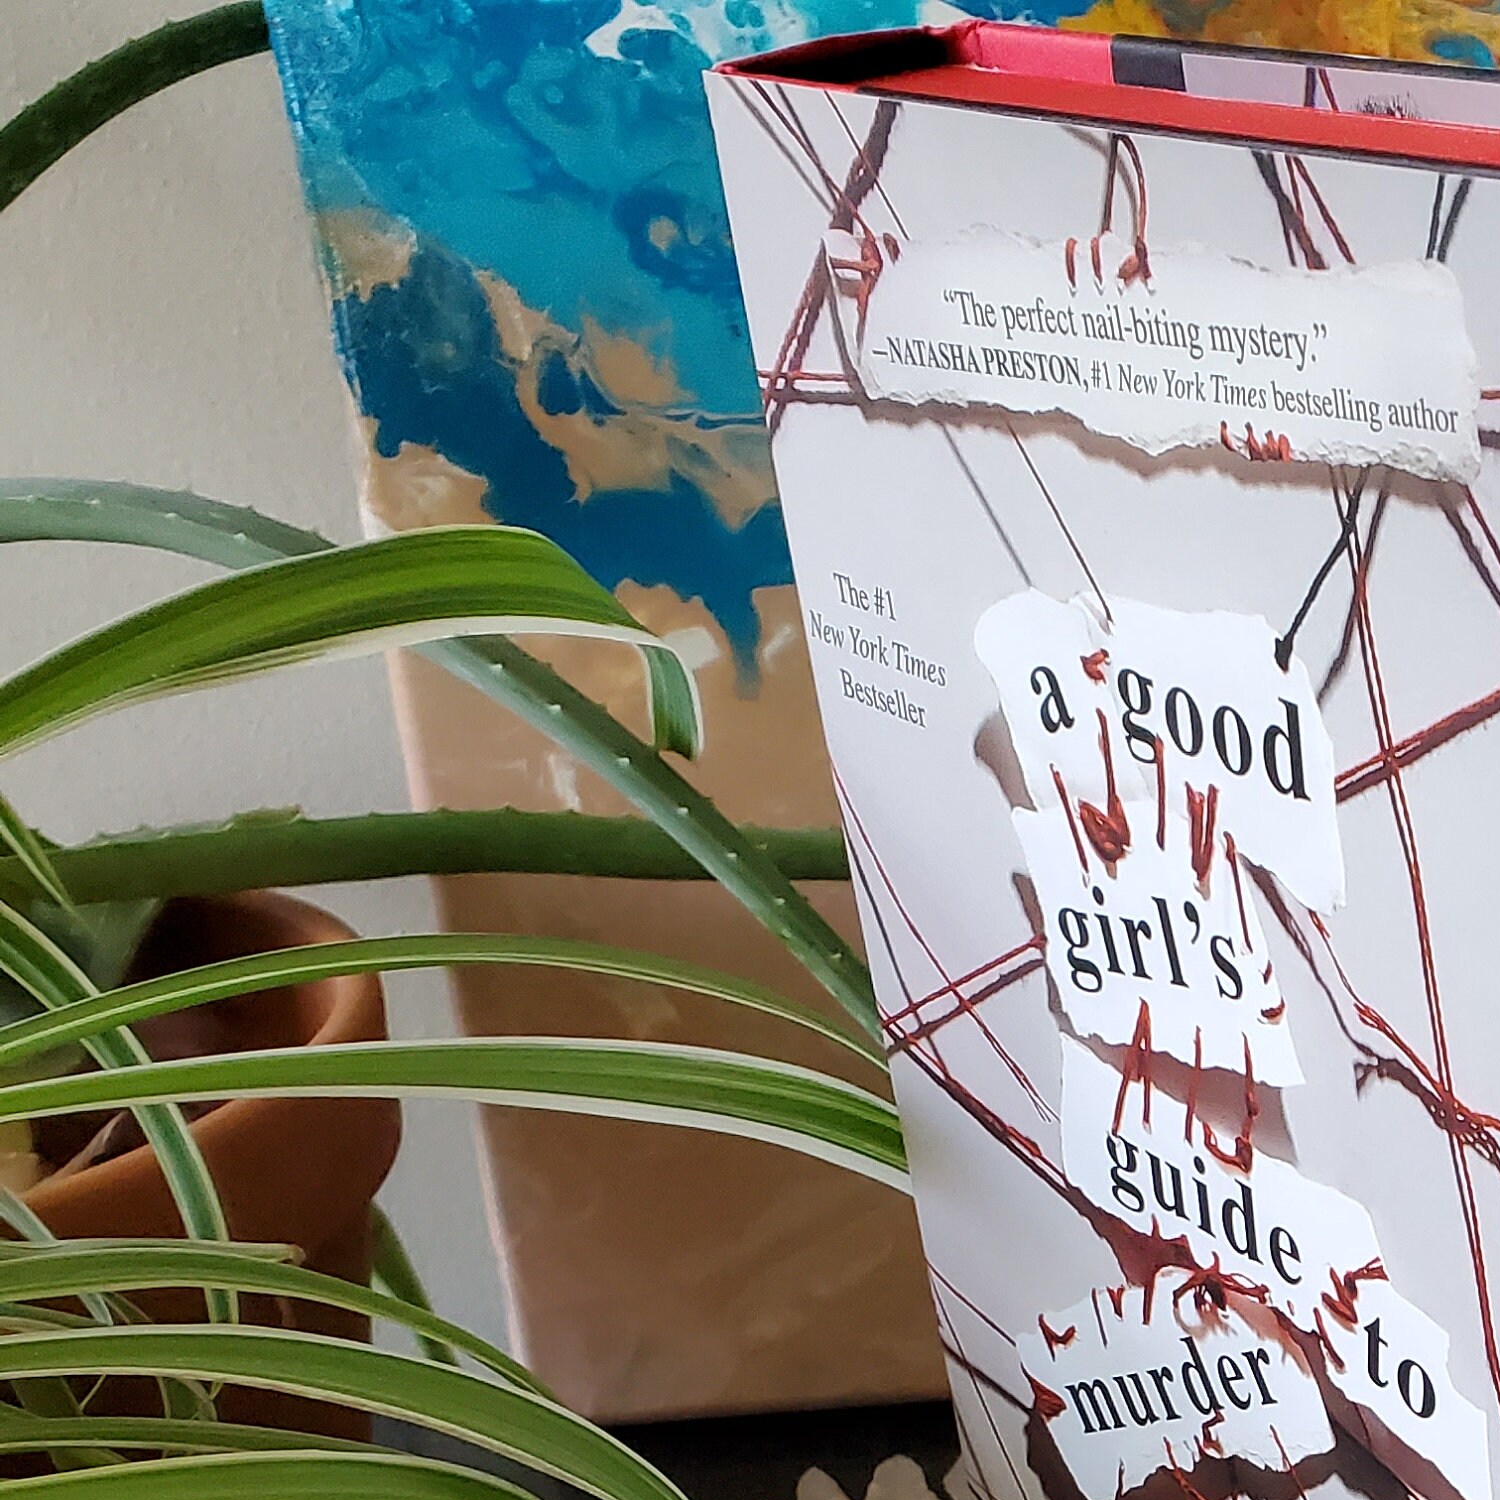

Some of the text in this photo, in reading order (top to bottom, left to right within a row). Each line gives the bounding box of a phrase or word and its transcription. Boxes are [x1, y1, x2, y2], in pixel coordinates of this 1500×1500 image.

[1001, 297, 1078, 340] perfect
[1081, 304, 1204, 360] nail-biting
[1091, 359, 1113, 392] #1
[1118, 363, 1158, 396] New
[1162, 368, 1207, 403] York
[1209, 373, 1267, 410] Times
[1270, 381, 1383, 432] bestselling
[1387, 397, 1459, 434] author
[833, 572, 897, 621] The #1
[809, 609, 946, 687] New York Times
[839, 668, 926, 728] Bestseller
[1030, 665, 1312, 801] a good
[1057, 885, 1244, 1000] girl’s
[1106, 1134, 1303, 1286] guide
[1064, 1337, 1279, 1434] murder
[1363, 1316, 1437, 1420] to
